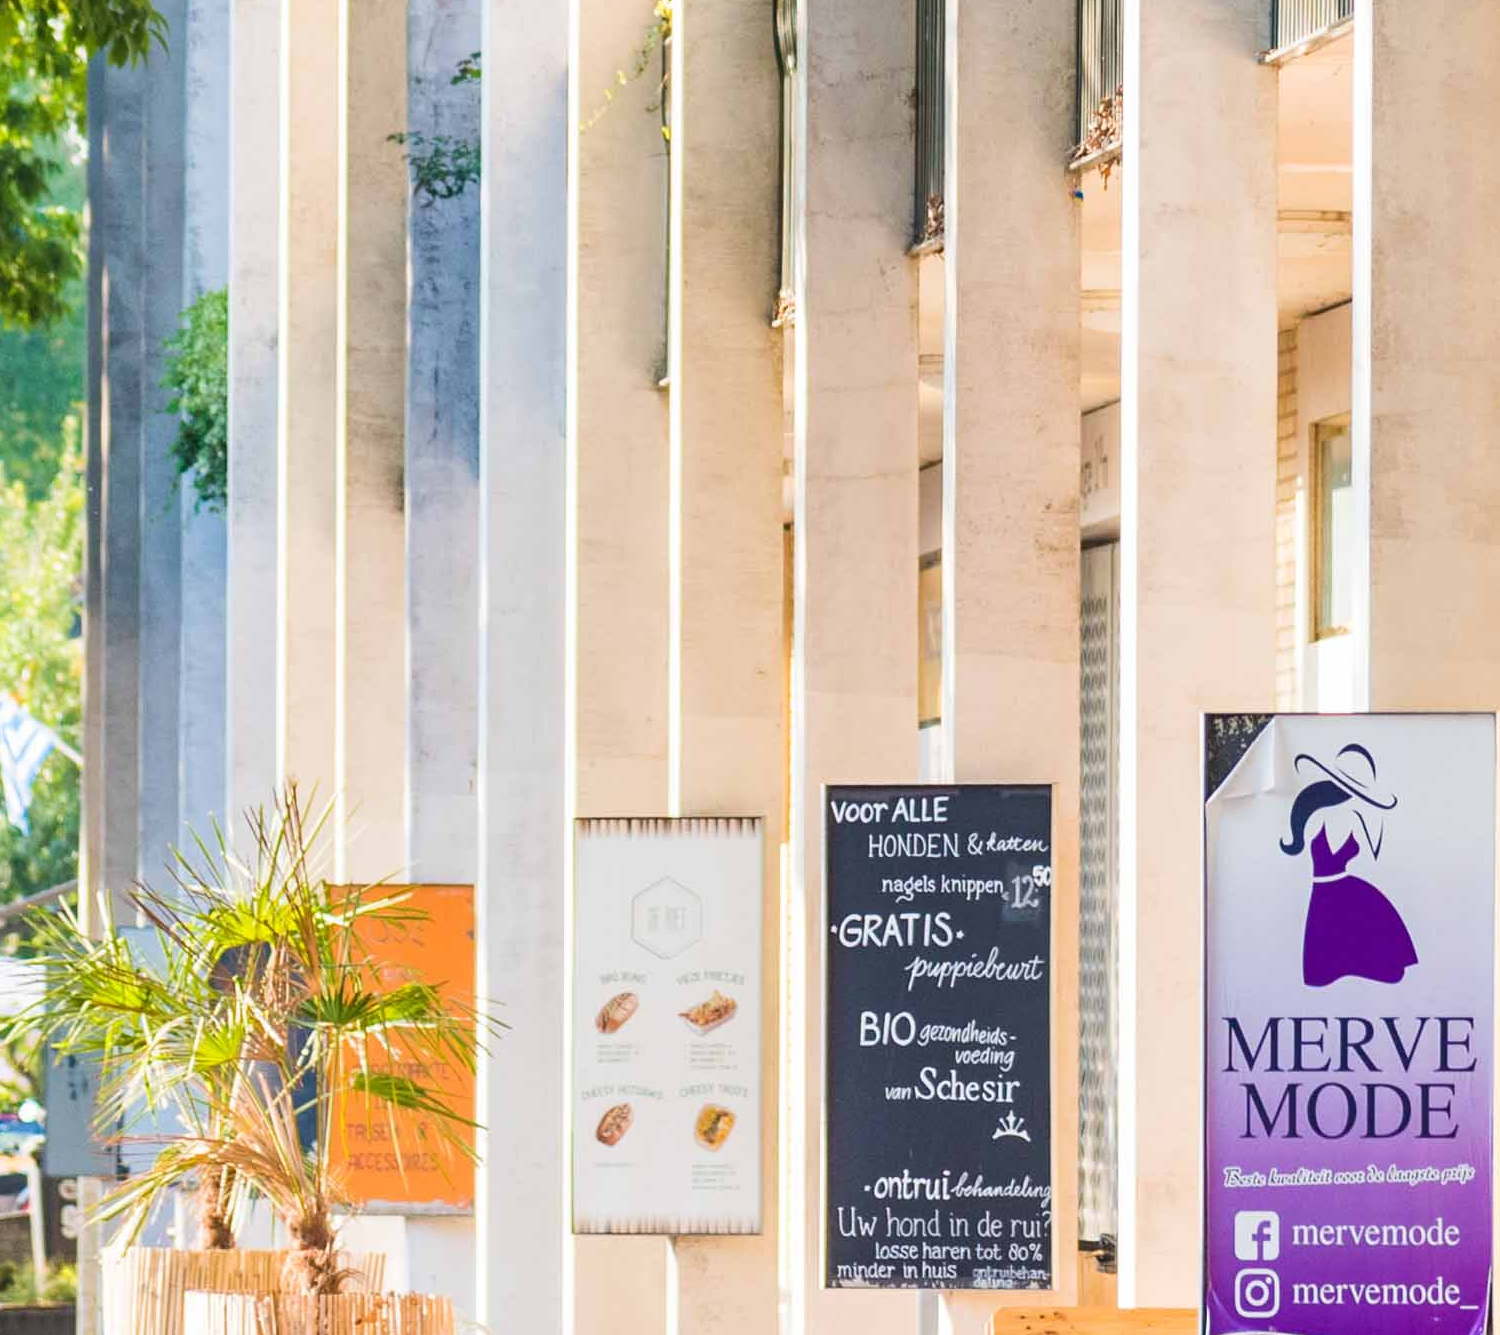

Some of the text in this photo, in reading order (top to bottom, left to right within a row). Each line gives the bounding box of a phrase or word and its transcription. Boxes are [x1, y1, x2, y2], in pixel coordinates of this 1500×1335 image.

[831, 796, 950, 823] voor ALLE
[868, 831, 1049, 858] HONDEN & katten
[882, 874, 936, 903] nagels
[941, 874, 1003, 901] knippen
[904, 946, 1045, 991] puppiebeurt
[860, 1010, 1017, 1047] BIO gezondheids-
[955, 1047, 1014, 1072] voeding
[1222, 1016, 1478, 1073] MERVE
[885, 1066, 1020, 1103] van Schesir
[1239, 1082, 1459, 1140] MODE
[1223, 1166, 1265, 1188] Beste
[1268, 1167, 1331, 1186] kwaliteit
[1367, 1165, 1383, 1183] de
[1386, 1165, 1439, 1186] laagste
[1441, 1164, 1475, 1186] prijs
[837, 1205, 1052, 1239] Uw hond in de rui?
[1292, 1217, 1461, 1248] mervemode
[875, 1242, 1043, 1262] losse haren tot 80%
[837, 1261, 957, 1281] minder in huis
[1292, 1276, 1479, 1311] mervemode_
